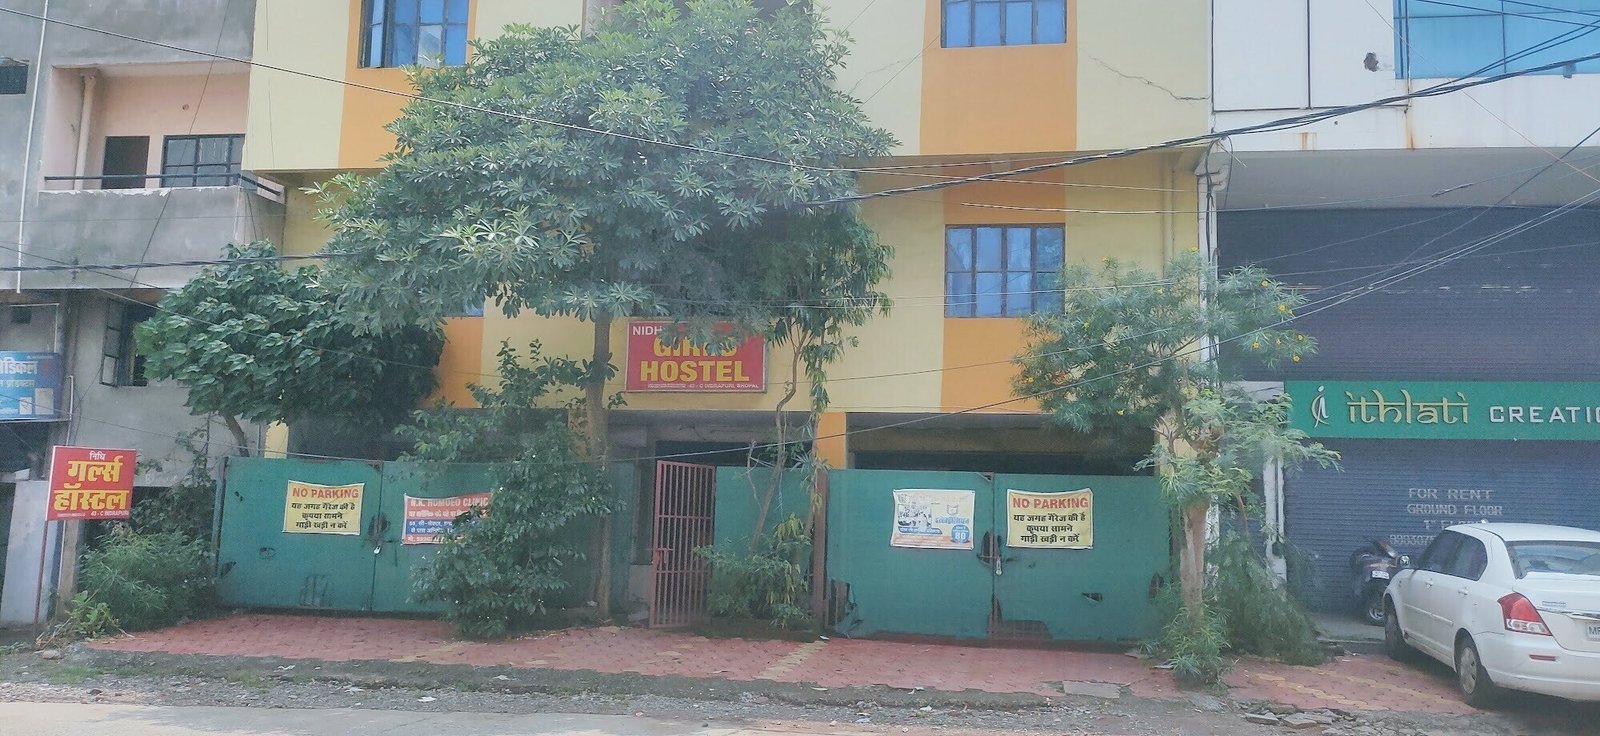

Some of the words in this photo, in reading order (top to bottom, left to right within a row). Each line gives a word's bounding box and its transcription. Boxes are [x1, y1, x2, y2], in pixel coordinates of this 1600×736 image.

[632, 325, 662, 336] NIDH
[640, 360, 750, 382] HOSTEL
[1344, 389, 1469, 424] ithlati
[89, 450, 106, 461] निधि
[67, 455, 124, 482] गर्ल्स
[53, 482, 130, 511] हॉस्टल
[292, 487, 308, 498] NO
[311, 488, 359, 499] PARKING
[1408, 487, 1438, 500] FOR
[1447, 488, 1494, 500] RENT
[291, 502, 302, 510] यह
[1012, 497, 1030, 509] NO
[1033, 497, 1089, 509] PARKING
[1406, 503, 1457, 515] GROUND
[1463, 504, 1503, 516] FLOOR
[1013, 514, 1026, 522] यह
[1026, 514, 1047, 522] जगह
[1067, 512, 1079, 522] की
[1079, 511, 1086, 522] है
[1026, 524, 1049, 534] कृपया
[1050, 523, 1073, 532] सामने
[1020, 533, 1038, 544] गाड़ी
[1040, 533, 1058, 544] खड़ी
[1067, 533, 1080, 542] करें
